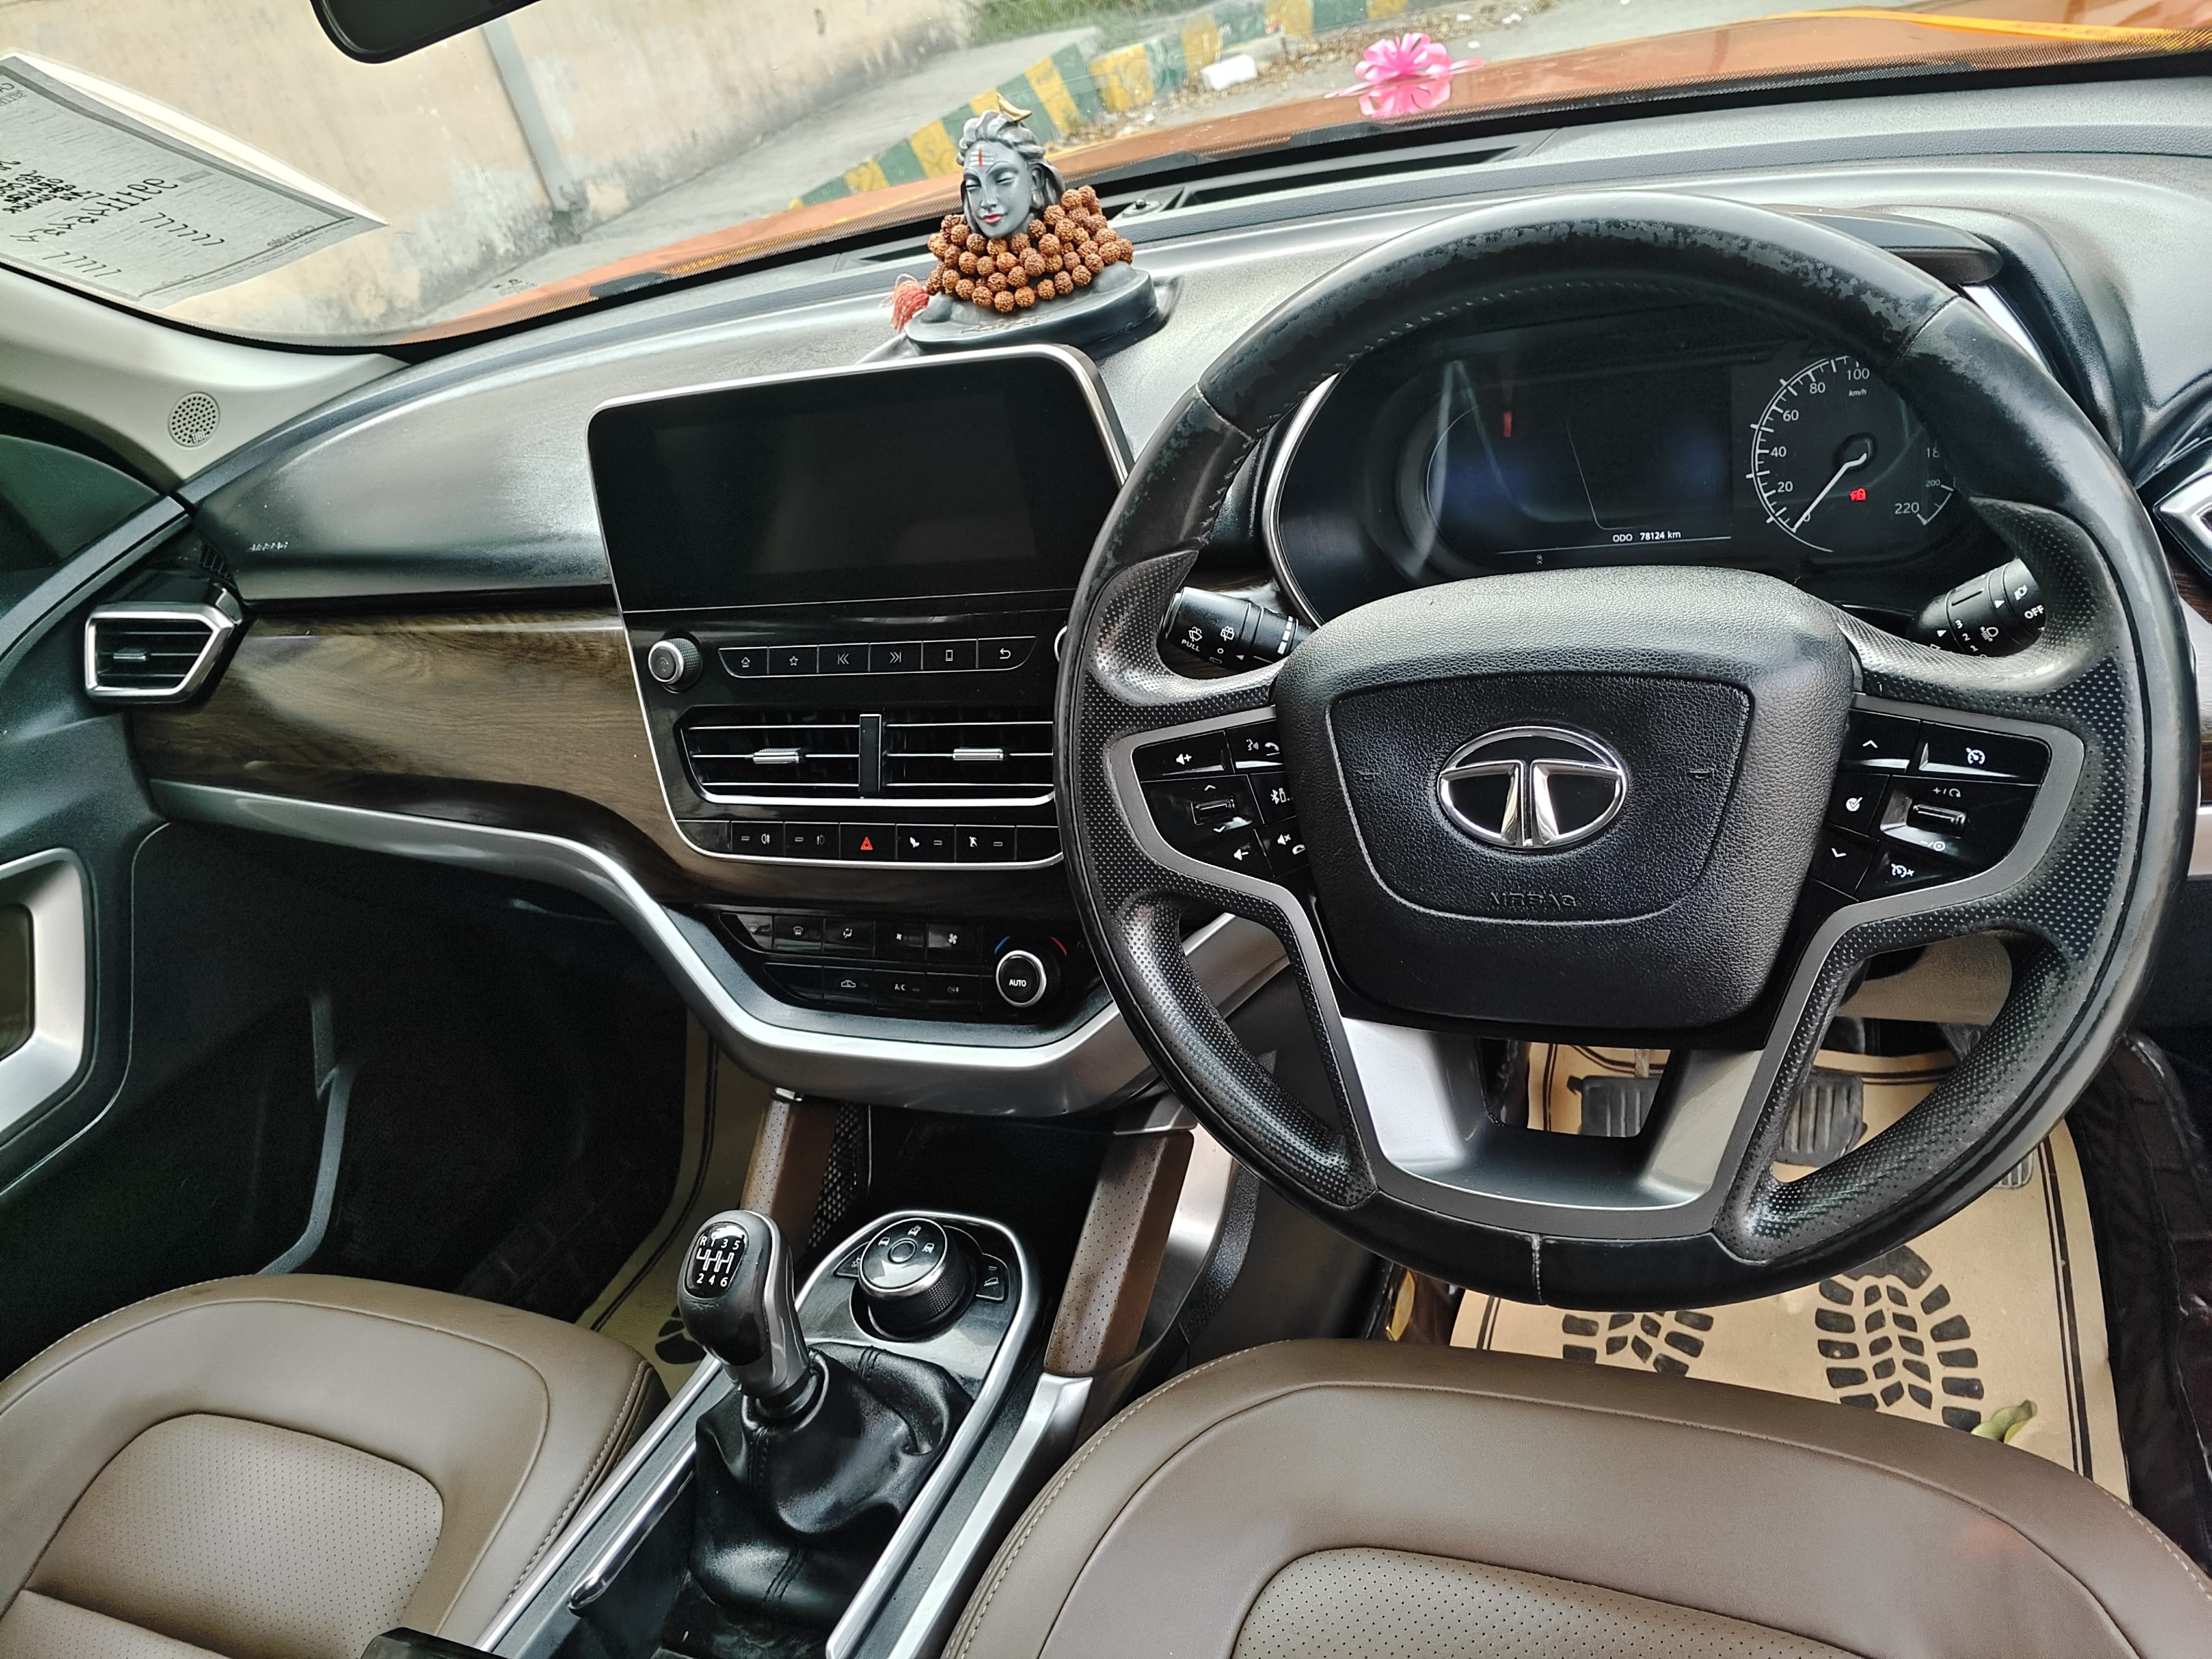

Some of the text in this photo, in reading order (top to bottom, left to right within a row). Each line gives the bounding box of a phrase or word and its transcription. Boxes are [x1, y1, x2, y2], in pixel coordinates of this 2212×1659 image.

[1846, 368, 1870, 381] 100
[1809, 382, 1826, 394] 80
[1849, 388, 1867, 396] km/h
[1783, 409, 1799, 421] 60
[1770, 447, 1787, 458] 40
[1777, 481, 1793, 492] 20
[1925, 479, 1940, 487] 200
[1894, 503, 1920, 515] 220
[1612, 531, 1681, 543] ODO 78124 km
[2024, 604, 2044, 619] OFF
[1955, 619, 1979, 652] 3 2 1
[1181, 638, 1200, 652] PULL
[1008, 979, 1027, 988] AUTO
[699, 1235, 707, 1246] R
[720, 1238, 729, 1249] 3
[732, 1240, 740, 1250] 5
[696, 1273, 729, 1287] 2 4 6
